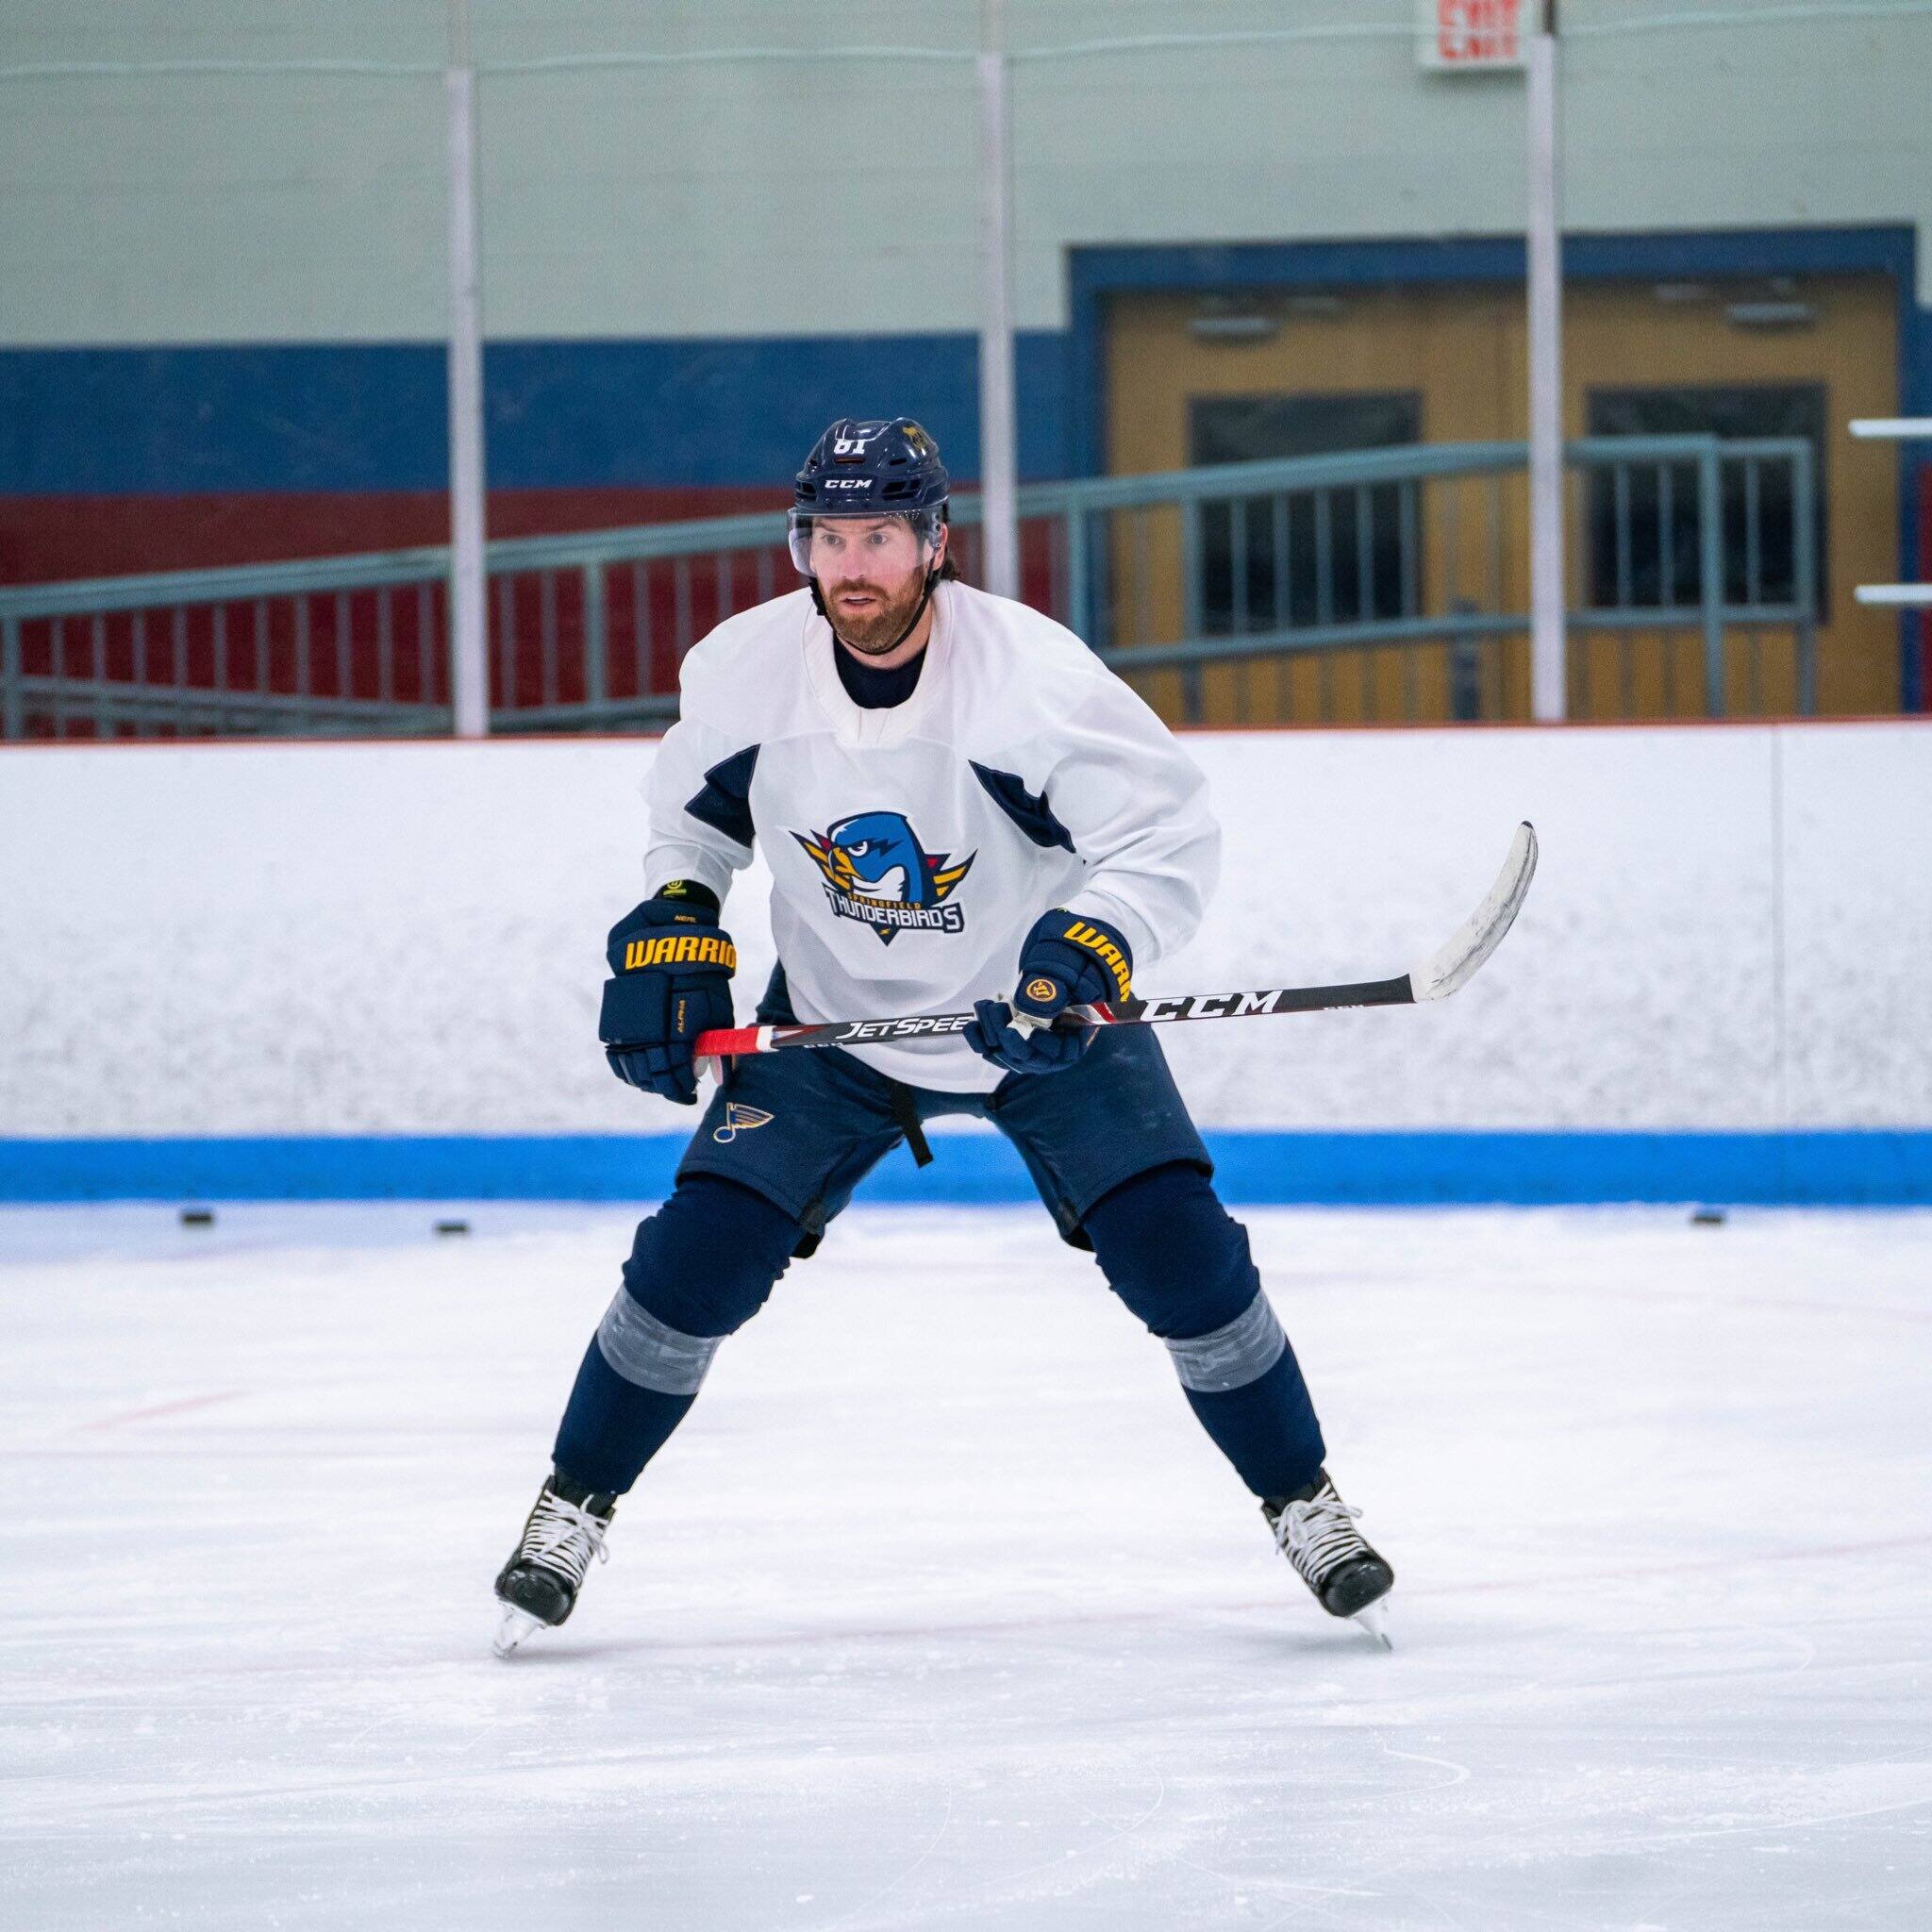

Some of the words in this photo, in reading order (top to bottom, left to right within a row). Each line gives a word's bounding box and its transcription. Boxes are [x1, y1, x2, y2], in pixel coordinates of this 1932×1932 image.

[824, 479, 873, 489] CCM
[824, 886, 962, 930] THUNDERBIRDS
[1140, 990, 1284, 1023] CCM
